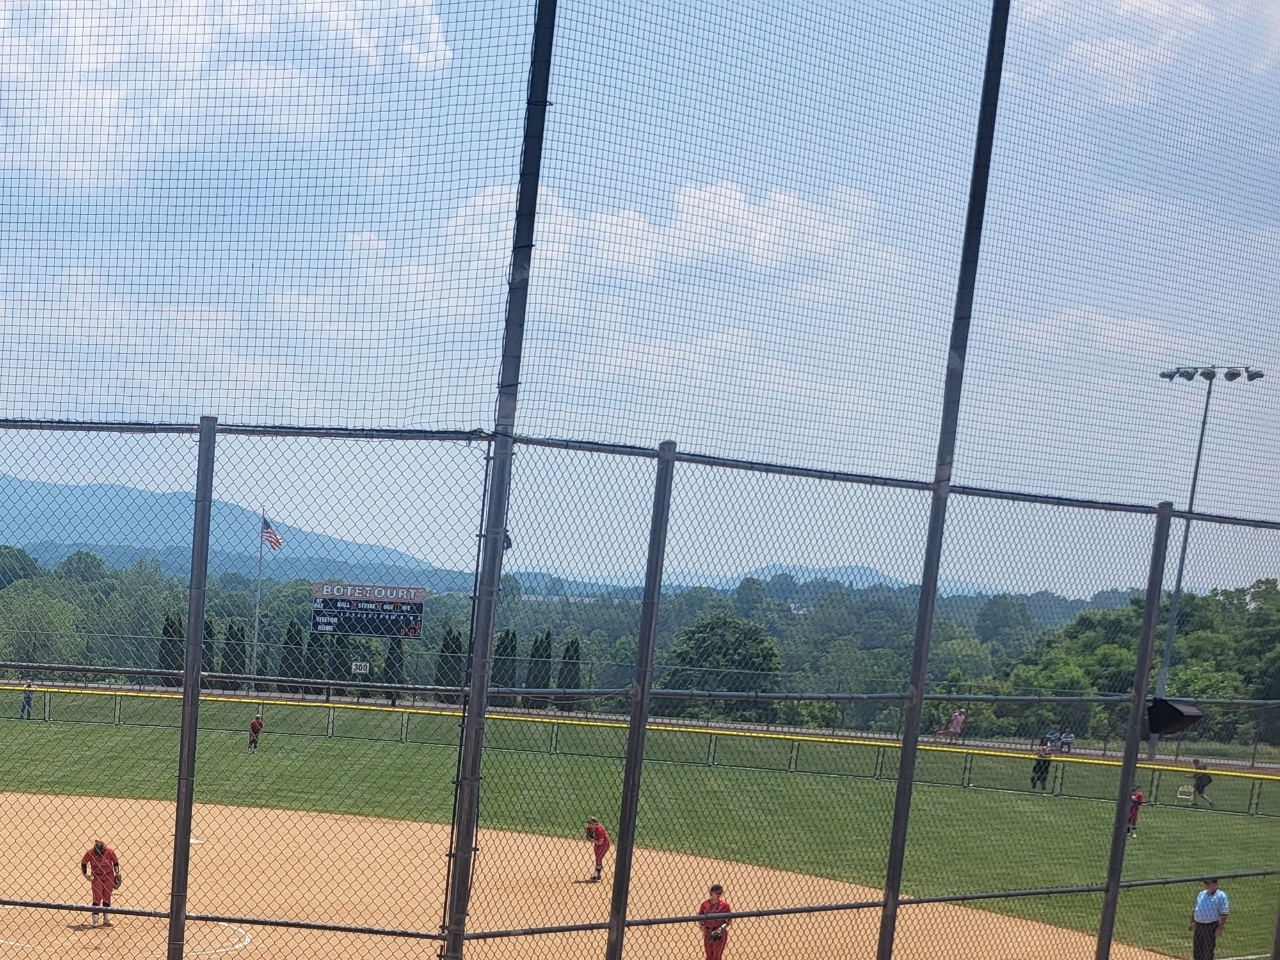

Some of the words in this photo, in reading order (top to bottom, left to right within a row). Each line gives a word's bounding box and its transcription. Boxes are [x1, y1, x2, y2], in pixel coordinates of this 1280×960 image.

[322, 585, 418, 600] BOTETOURT
[316, 616, 338, 624] VISITOR
[353, 663, 368, 672] 300
